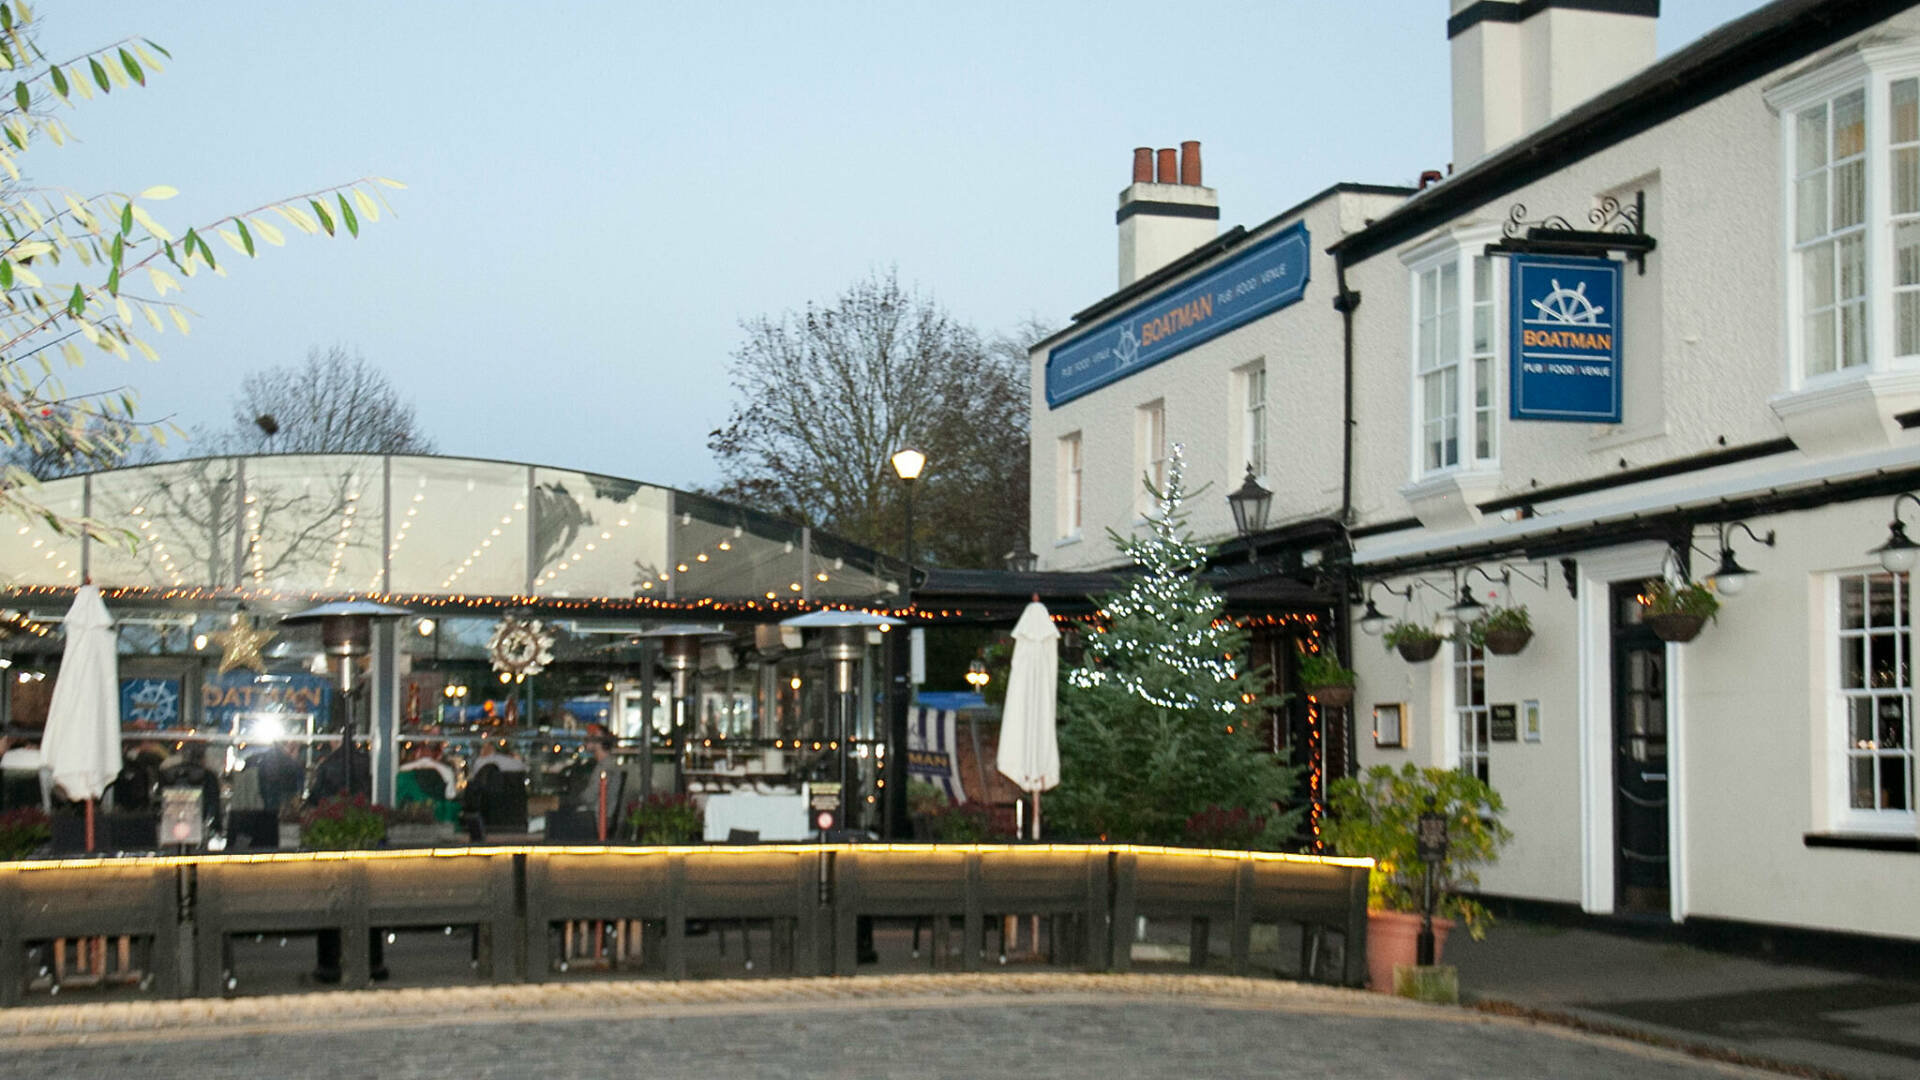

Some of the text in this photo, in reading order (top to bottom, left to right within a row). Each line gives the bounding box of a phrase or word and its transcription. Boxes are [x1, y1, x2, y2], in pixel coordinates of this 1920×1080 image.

[1142, 294, 1212, 346] BOATMAN
[1523, 329, 1611, 350] BOATMAN
[1523, 362, 1611, 377] PUB FOOD VENUE
